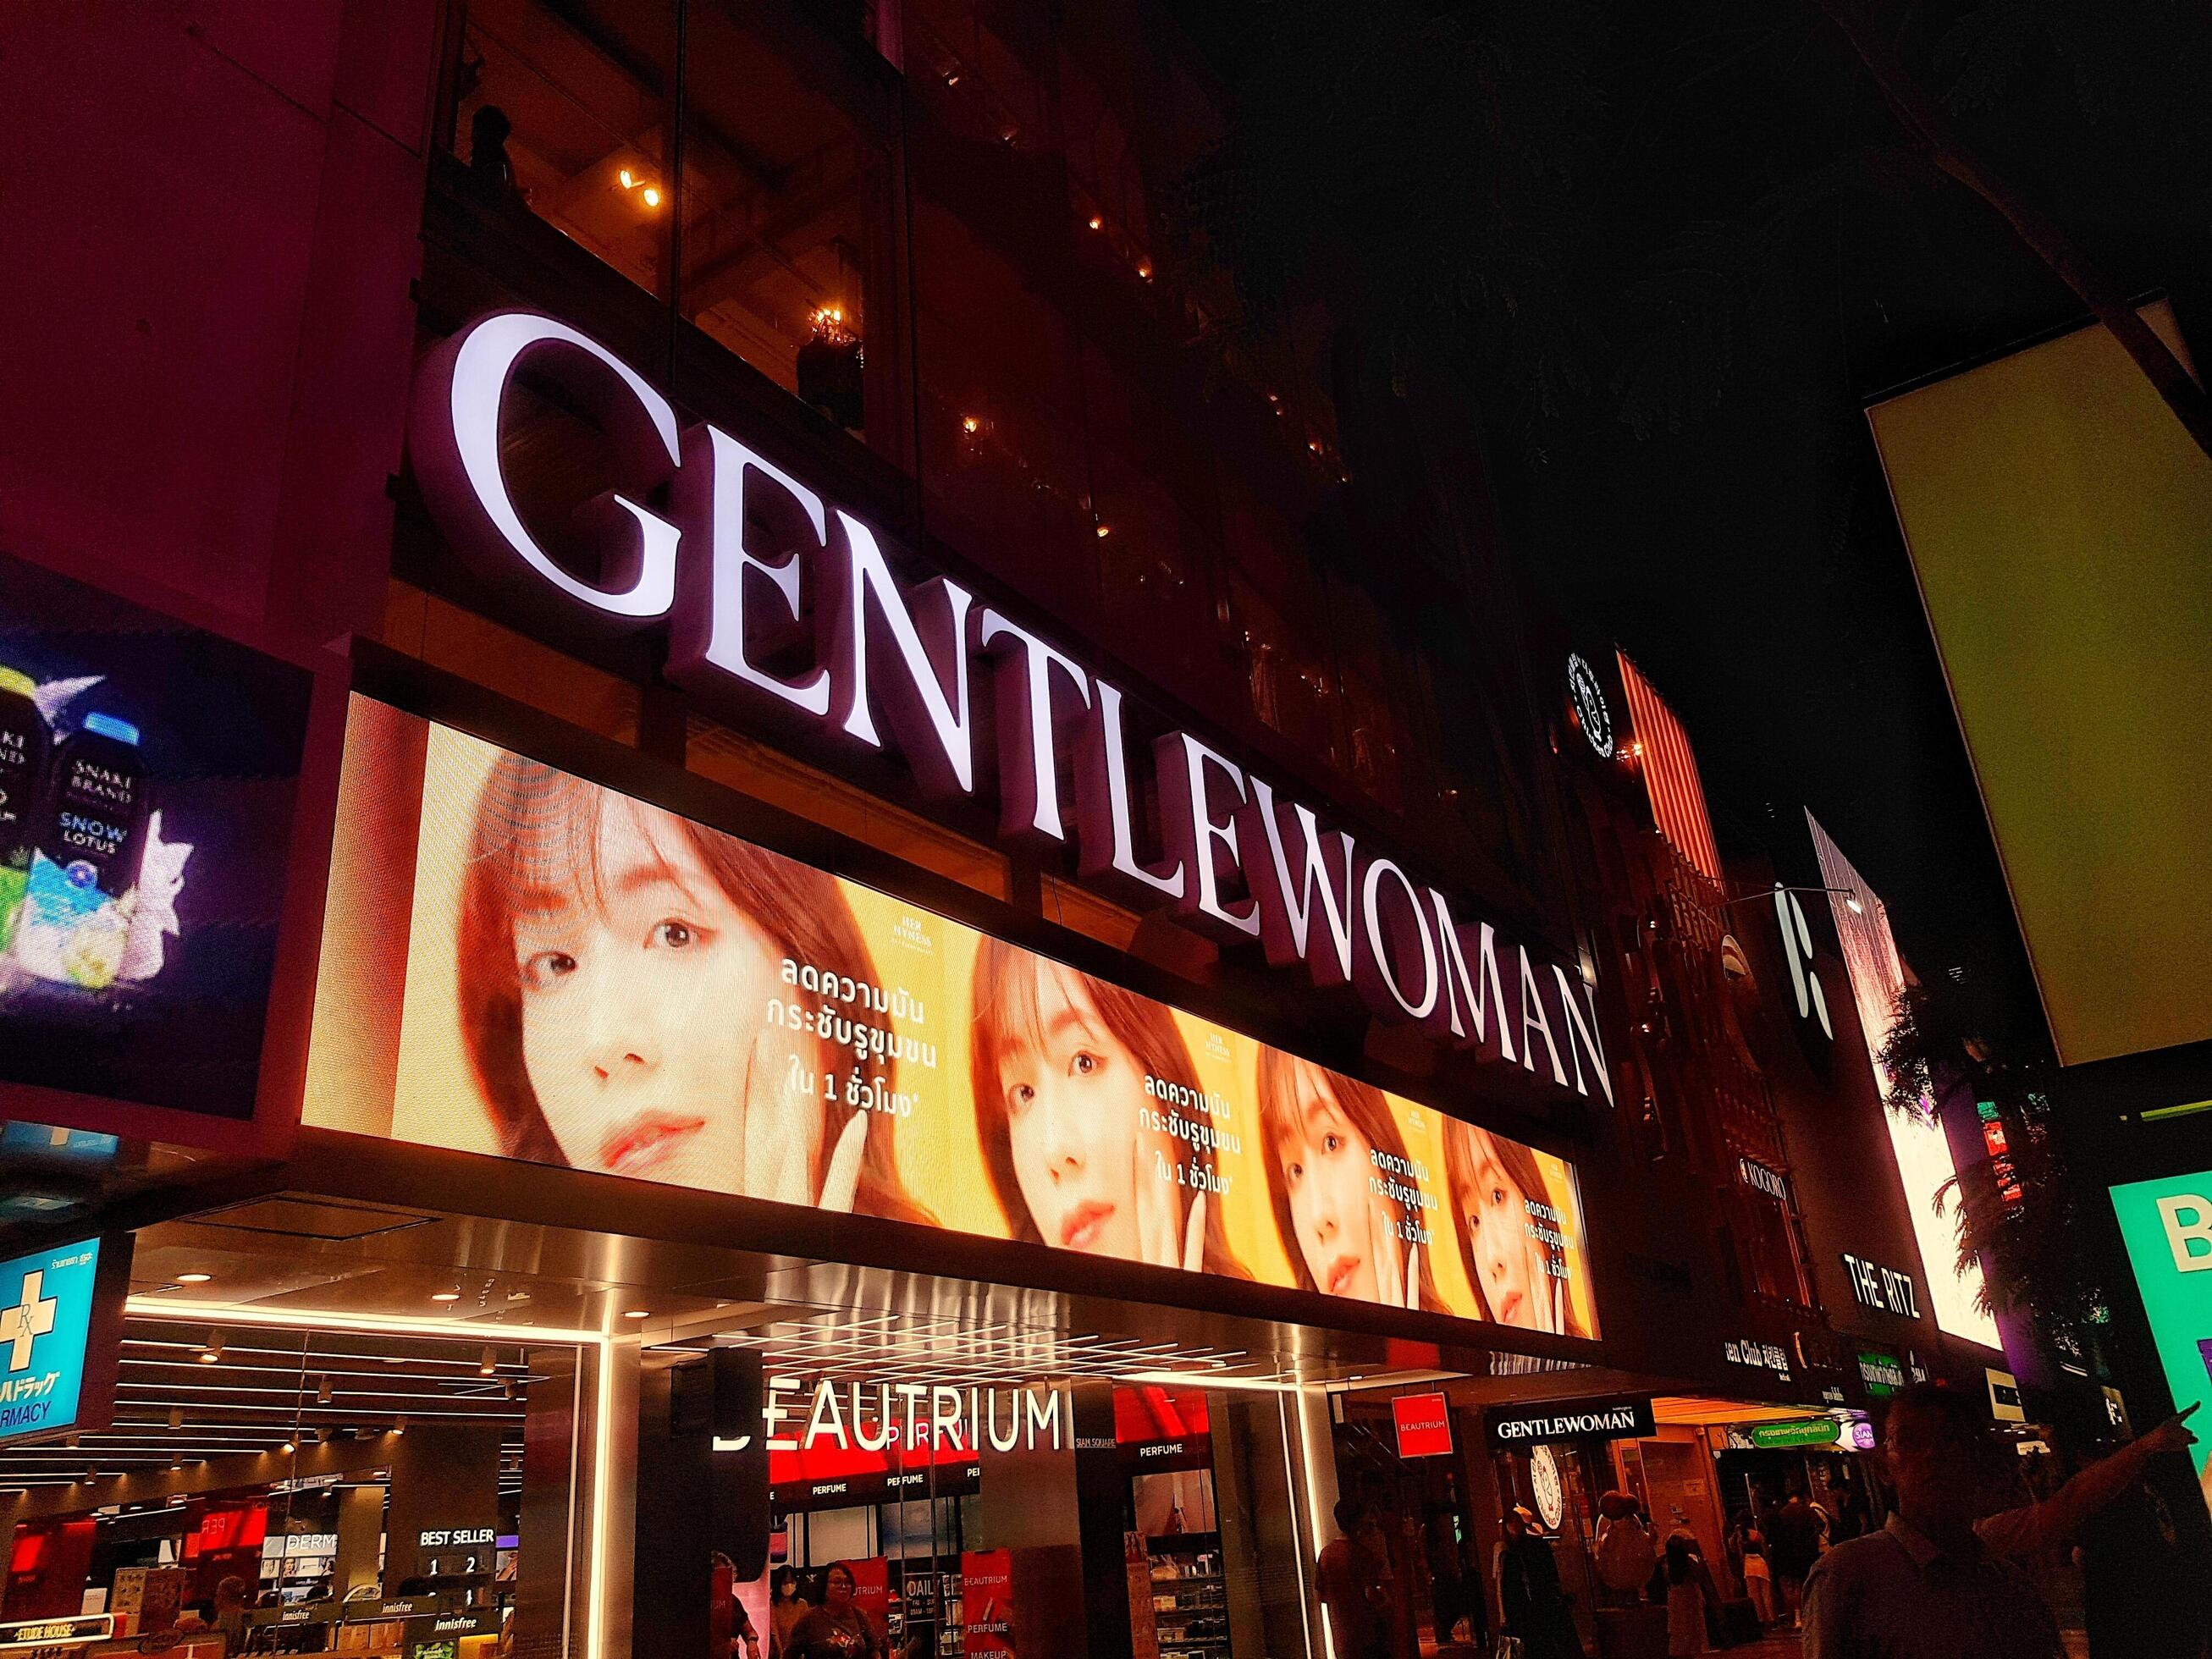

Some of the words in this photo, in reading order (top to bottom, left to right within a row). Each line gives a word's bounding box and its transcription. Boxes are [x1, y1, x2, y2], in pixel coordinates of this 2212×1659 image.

[450, 312, 1614, 1108] GENTLEWOMAN
[59, 812, 128, 842] SNOW
[63, 830, 117, 854] LOTUS
[781, 957, 924, 1025] ลดความมัน
[766, 997, 937, 1069] กระชับรูขุมขน
[788, 1054, 814, 1094] ใน
[825, 1072, 838, 1101] 1
[1145, 1074, 1231, 1120] ลดความมัน
[1155, 1149, 1172, 1182] ใน
[1177, 1163, 1186, 1186] 1
[1844, 1254, 1884, 1309] THE
[1881, 1267, 1921, 1319] RITZ
[1740, 1339, 1762, 1366] Club
[713, 1377, 1059, 1452] EAUTRIUM
[1400, 1419, 1445, 1432] BEAUTRIUM
[1498, 1411, 1635, 1439] GENTLEWOMAN
[1140, 1443, 1183, 1458] PERFUME
[813, 1483, 847, 1495] PERFUME
[421, 1530, 451, 1546] BEST
[453, 1529, 494, 1544] SELLER
[430, 1558, 438, 1576] 1
[466, 1557, 476, 1574] 2
[964, 1575, 1007, 1586] BEAUTRIUM
[282, 1611, 310, 1621] innisfree
[383, 1601, 413, 1613] innisfree
[16, 1627, 44, 1641] ETUDE
[43, 1623, 74, 1639] HOUSE
[435, 1617, 477, 1632] innisfree
[968, 1623, 1008, 1634] PERFUME
